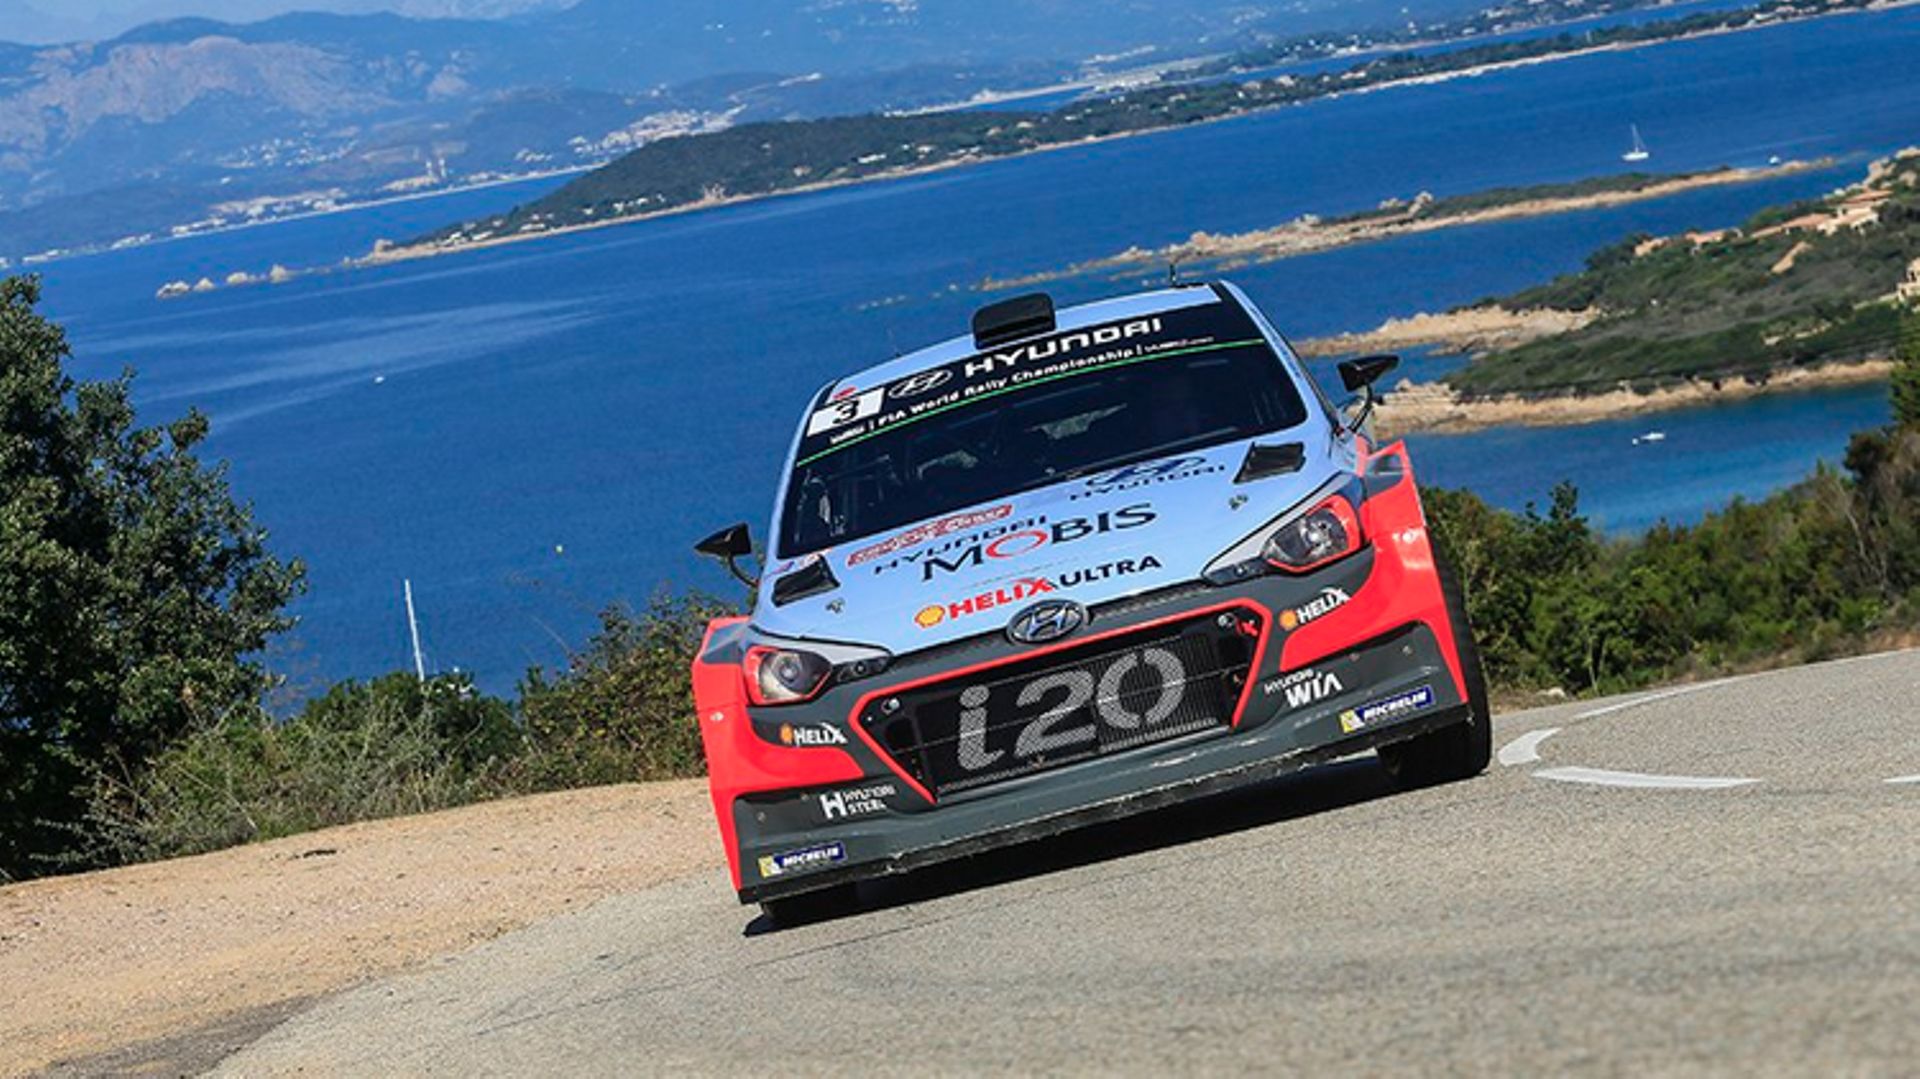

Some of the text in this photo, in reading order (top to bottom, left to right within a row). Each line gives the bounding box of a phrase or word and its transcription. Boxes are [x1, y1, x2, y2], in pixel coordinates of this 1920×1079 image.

[964, 318, 1163, 377] HYUNDAI
[832, 396, 861, 424] 3
[878, 347, 1134, 427] FIA World Rally Championship
[1070, 465, 1225, 501] HYUNDAI
[874, 515, 1047, 575] HYUNDAI
[922, 502, 1157, 581] MOBIS
[949, 577, 1054, 619] HELIX
[1059, 555, 1162, 588] ULTRA
[1296, 587, 1351, 624] HELIX
[957, 648, 1186, 770] i20
[1362, 691, 1427, 721] MICHELIN
[793, 722, 848, 746] HELIX
[782, 846, 840, 867] MICHELIN
